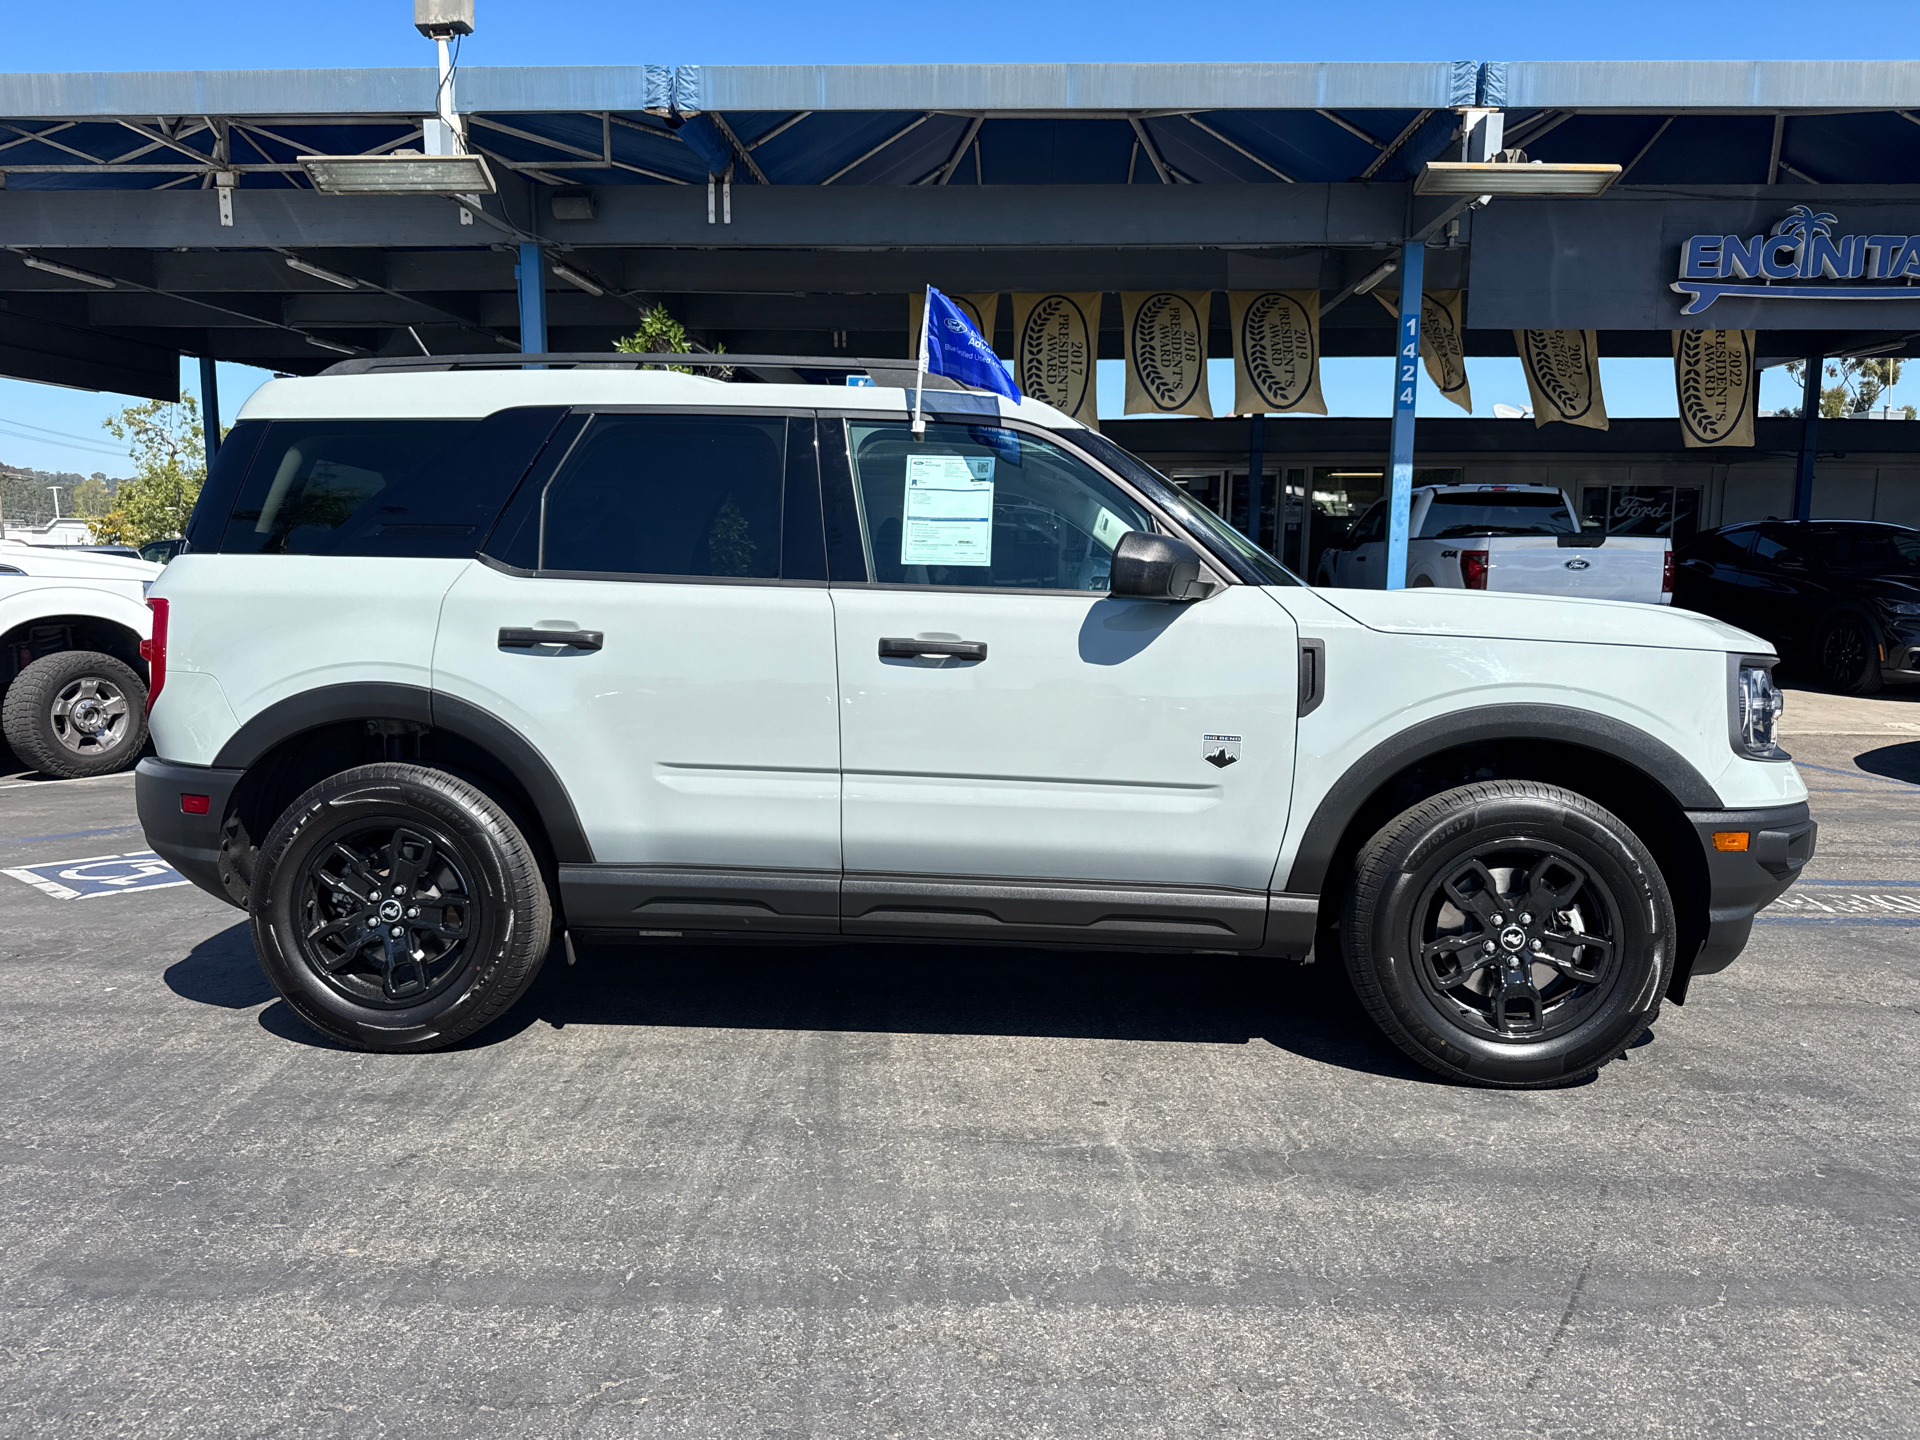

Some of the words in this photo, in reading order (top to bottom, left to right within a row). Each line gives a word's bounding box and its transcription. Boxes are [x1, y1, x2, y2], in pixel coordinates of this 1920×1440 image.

[1046, 332, 1058, 385] AWARD
[1056, 313, 1070, 409] PRESIDENT'S
[1070, 341, 1084, 376] 2017
[1158, 323, 1172, 368] AWARD
[1168, 307, 1184, 390] PRESIDENT'S
[1183, 330, 1197, 363] 2018
[1268, 322, 1283, 367] AWARD
[1278, 306, 1296, 388] PRESIDENT'S
[1294, 328, 1309, 360] 2019
[1555, 330, 1582, 399] RESIDENT'S
[1568, 343, 1584, 376] 2021
[1704, 341, 1716, 398] AWARD
[1715, 330, 1728, 421] RESIDENT'S
[1728, 350, 1743, 387] 2022
[1614, 496, 1671, 518] Ford
